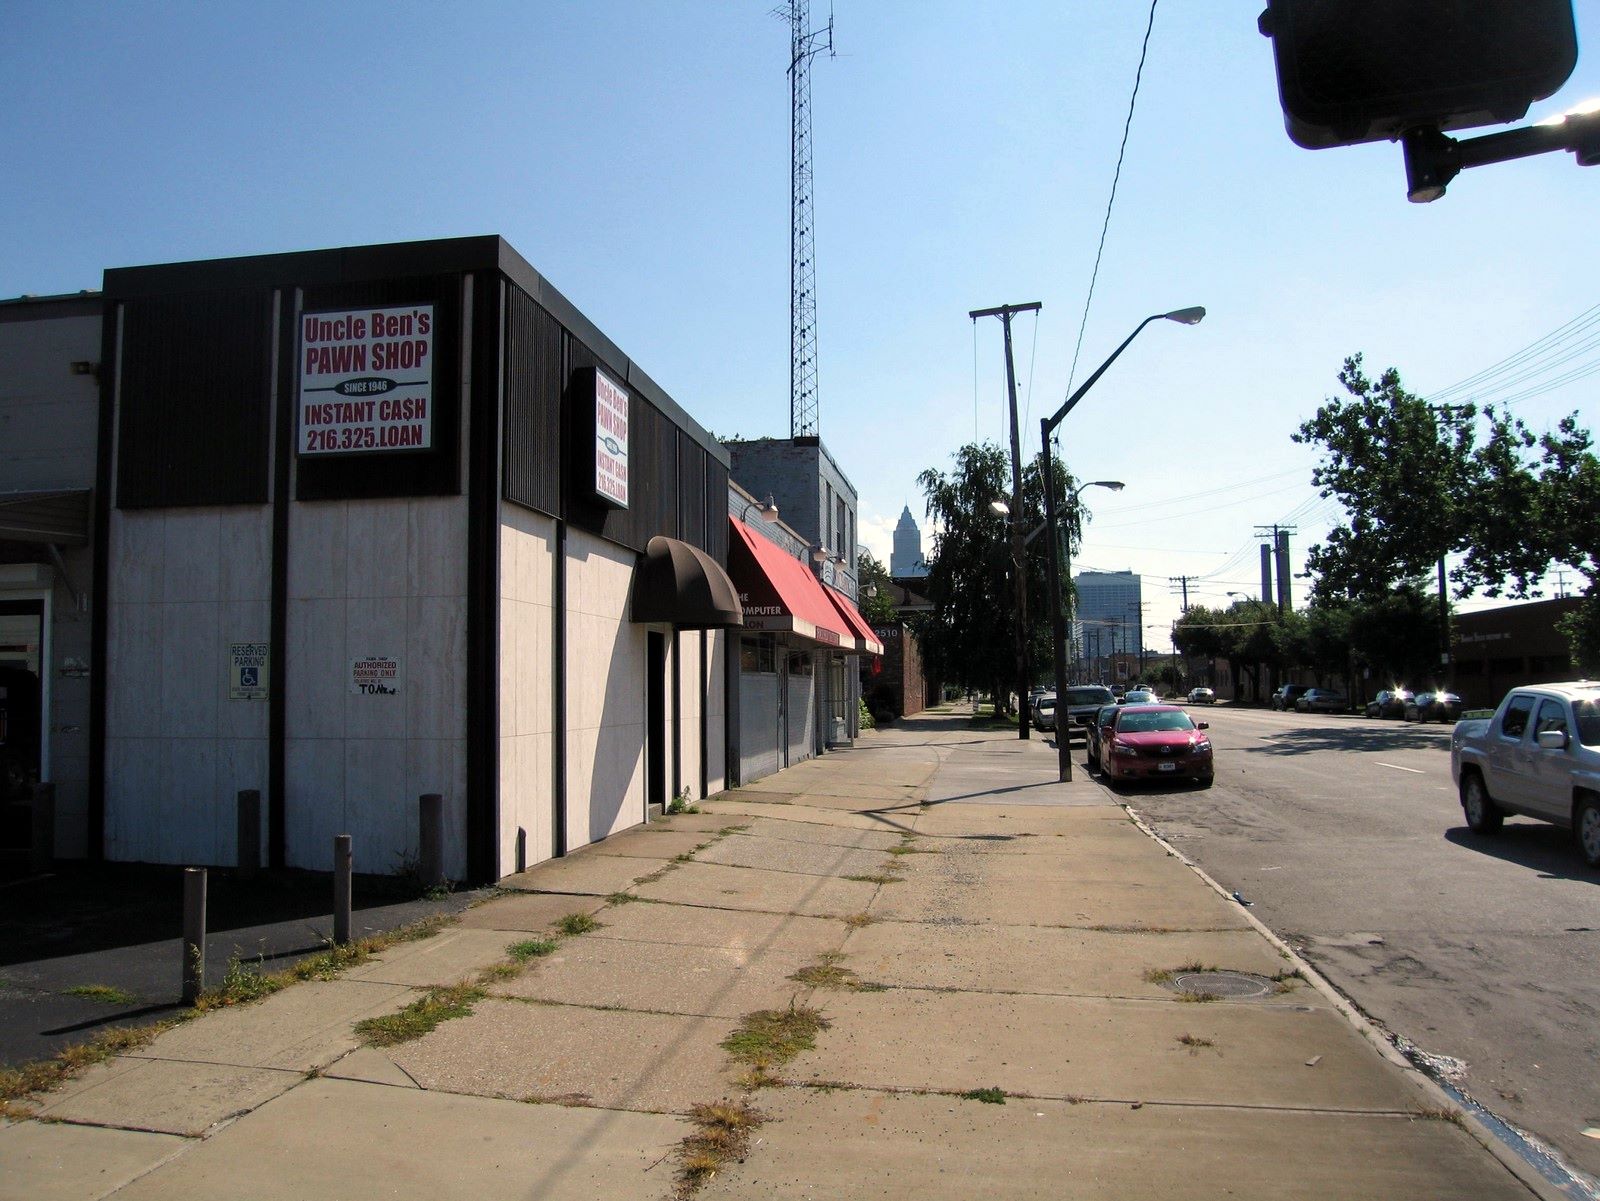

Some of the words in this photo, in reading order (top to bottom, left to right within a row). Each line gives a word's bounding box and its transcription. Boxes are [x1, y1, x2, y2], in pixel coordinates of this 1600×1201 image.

[305, 315, 366, 343] Uncle
[371, 310, 430, 338] Ben's
[306, 344, 366, 375] PAWN
[371, 340, 428, 371] SHOP
[344, 382, 367, 393] SINCE
[368, 381, 388, 392] 1946
[305, 401, 376, 425] INSTANT
[307, 424, 423, 450] 216.325.LOAN
[741, 606, 782, 615] OMPUTER
[231, 645, 268, 656] RESERVED
[234, 656, 265, 668] PARKING
[354, 661, 397, 669] AUTHORIZED
[353, 669, 378, 678] PARKING
[380, 669, 396, 677] ONLY
